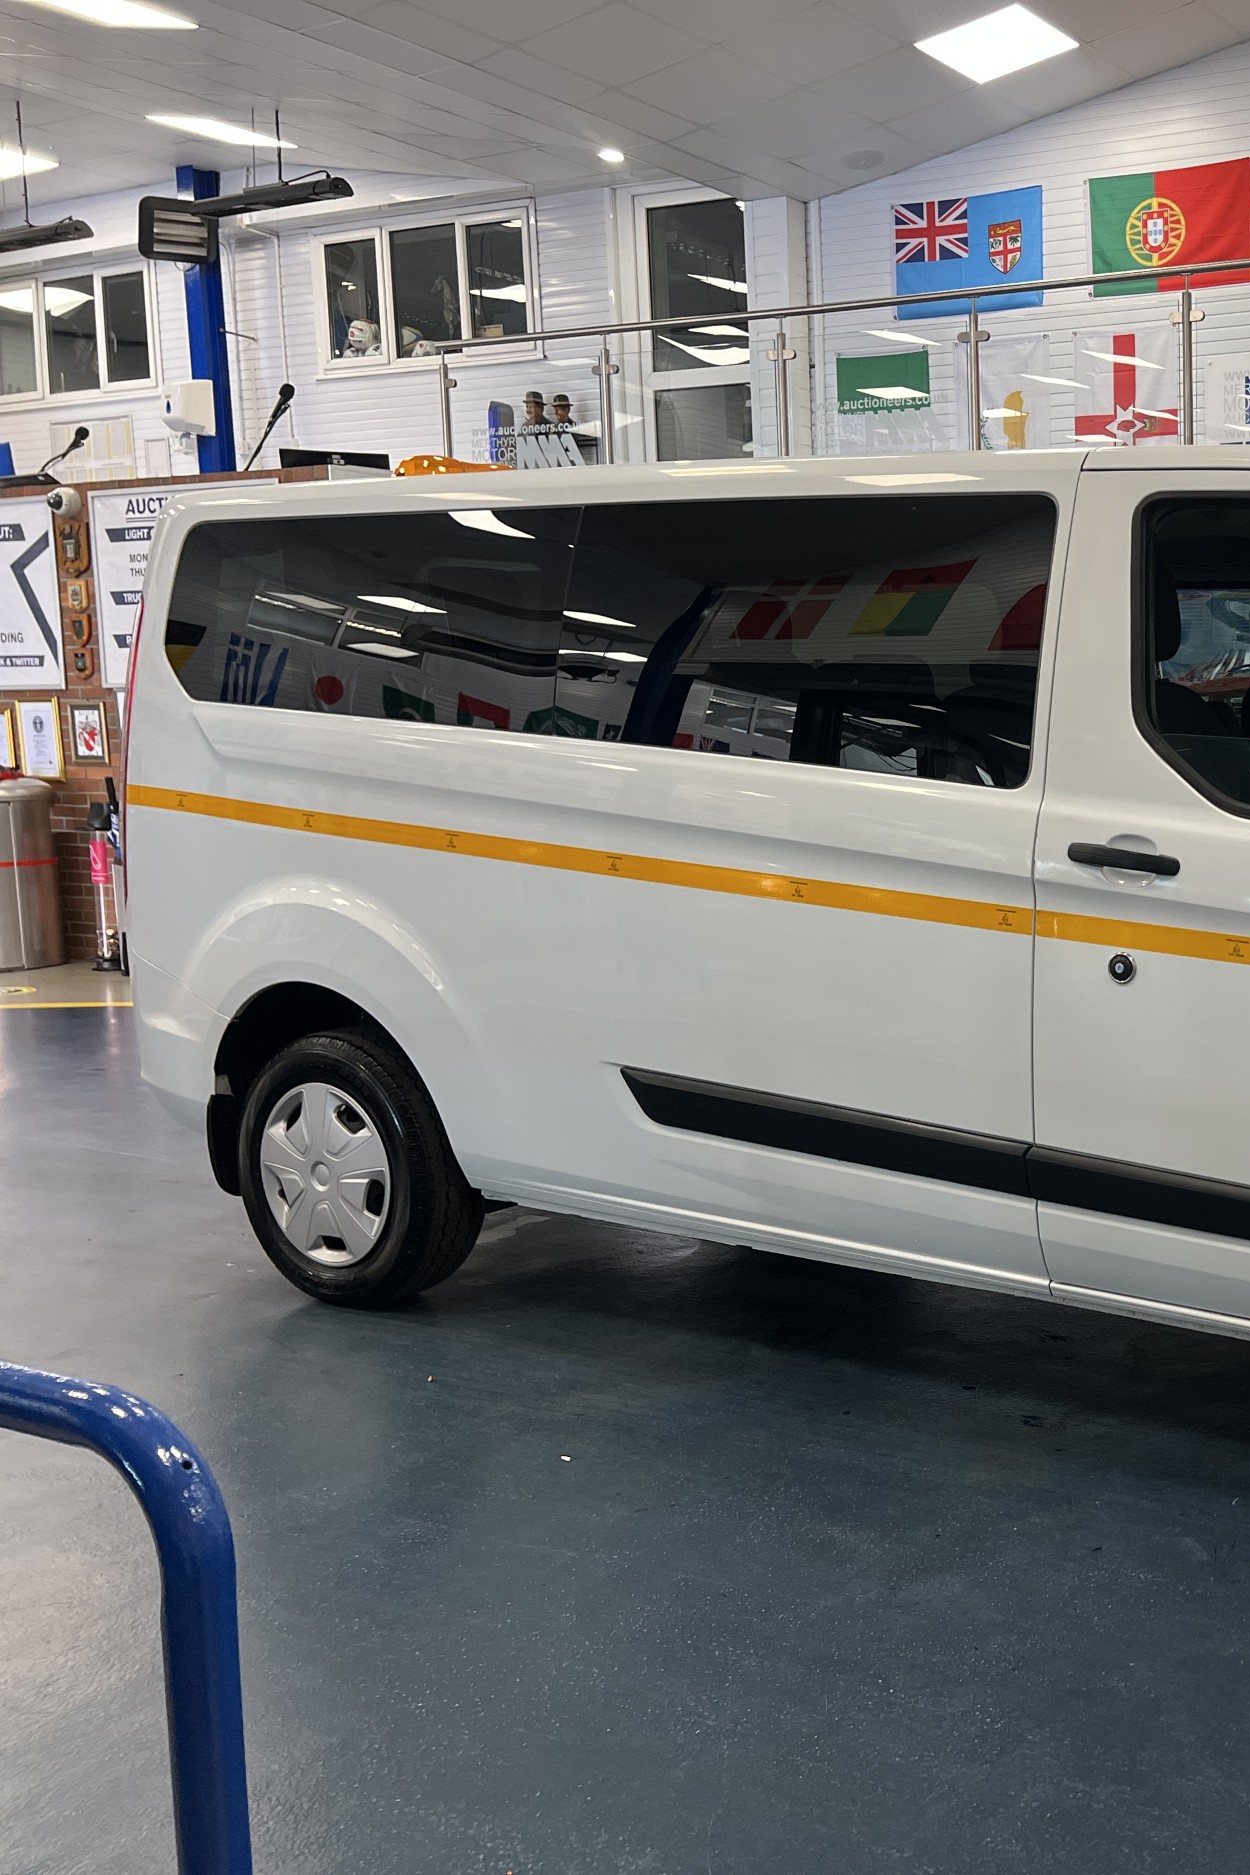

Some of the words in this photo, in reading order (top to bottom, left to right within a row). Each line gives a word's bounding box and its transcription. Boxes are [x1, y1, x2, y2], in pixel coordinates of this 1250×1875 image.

[472, 421, 584, 437] www.aucioneers.co.u
[125, 497, 168, 515] AUCT
[125, 528, 149, 540] LIGHT
[12, 657, 40, 666] TWITTER
